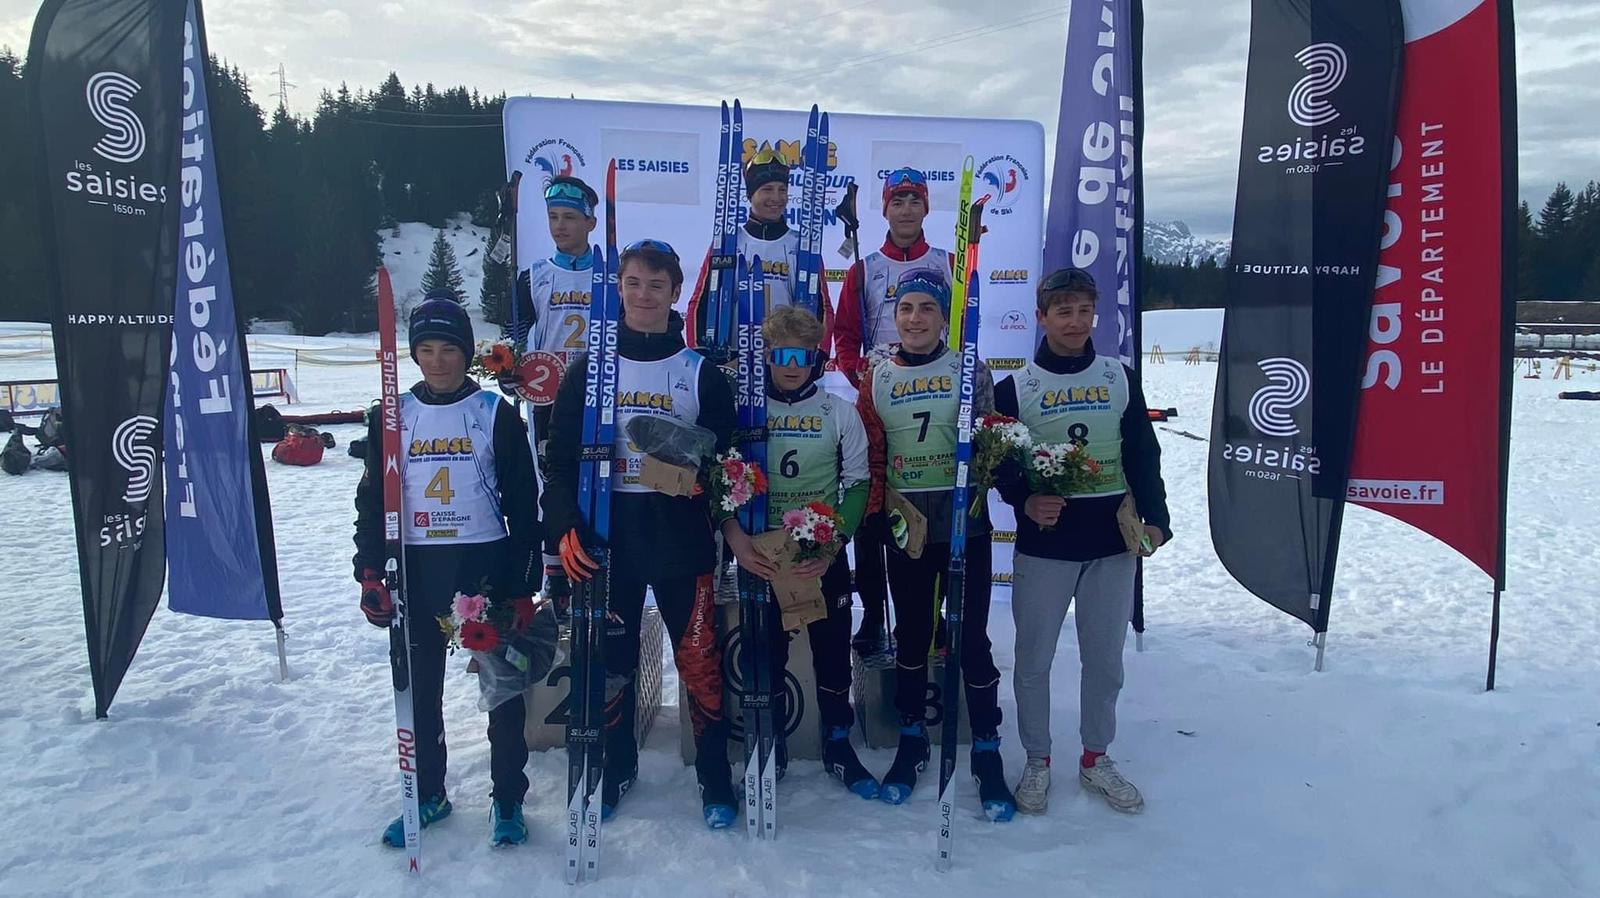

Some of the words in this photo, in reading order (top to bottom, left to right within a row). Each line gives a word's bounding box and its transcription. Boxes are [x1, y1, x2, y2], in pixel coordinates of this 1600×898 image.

[75, 160, 92, 171] les
[639, 160, 690, 174] SAISIES
[922, 169, 955, 182] AISIES
[66, 170, 167, 204] saisies
[714, 163, 727, 236] SALOMON
[728, 162, 740, 235] SALOMON
[801, 167, 814, 238] SALOMON
[811, 172, 826, 242] SALOMON
[956, 199, 971, 285] FISCHER
[1415, 122, 1444, 344] DÉPARTEMENT
[551, 291, 592, 306] SAMS
[68, 314, 115, 325] HAPPY
[564, 313, 586, 349] 2
[528, 365, 550, 392] 2
[586, 319, 601, 408] SALOMON
[602, 319, 618, 408] SALOMON
[738, 324, 749, 407] SALOMON
[753, 325, 764, 408] SALOMON
[961, 342, 976, 404] LOMON
[1421, 360, 1444, 393] LE
[384, 351, 397, 432] MADSHUS
[890, 376, 953, 399] SAMSE
[1040, 385, 1111, 410] SAMSE
[912, 411, 931, 442] 7
[1067, 422, 1089, 447] 8
[409, 438, 473, 457] SAMSE
[780, 449, 800, 478] 6
[904, 455, 927, 463] CAISSE
[424, 466, 455, 505] 4
[1347, 484, 1438, 500] savoie.fr
[104, 514, 122, 524] les
[544, 666, 571, 724] 2
[397, 728, 416, 773] PRO
[405, 774, 413, 799] RACE
